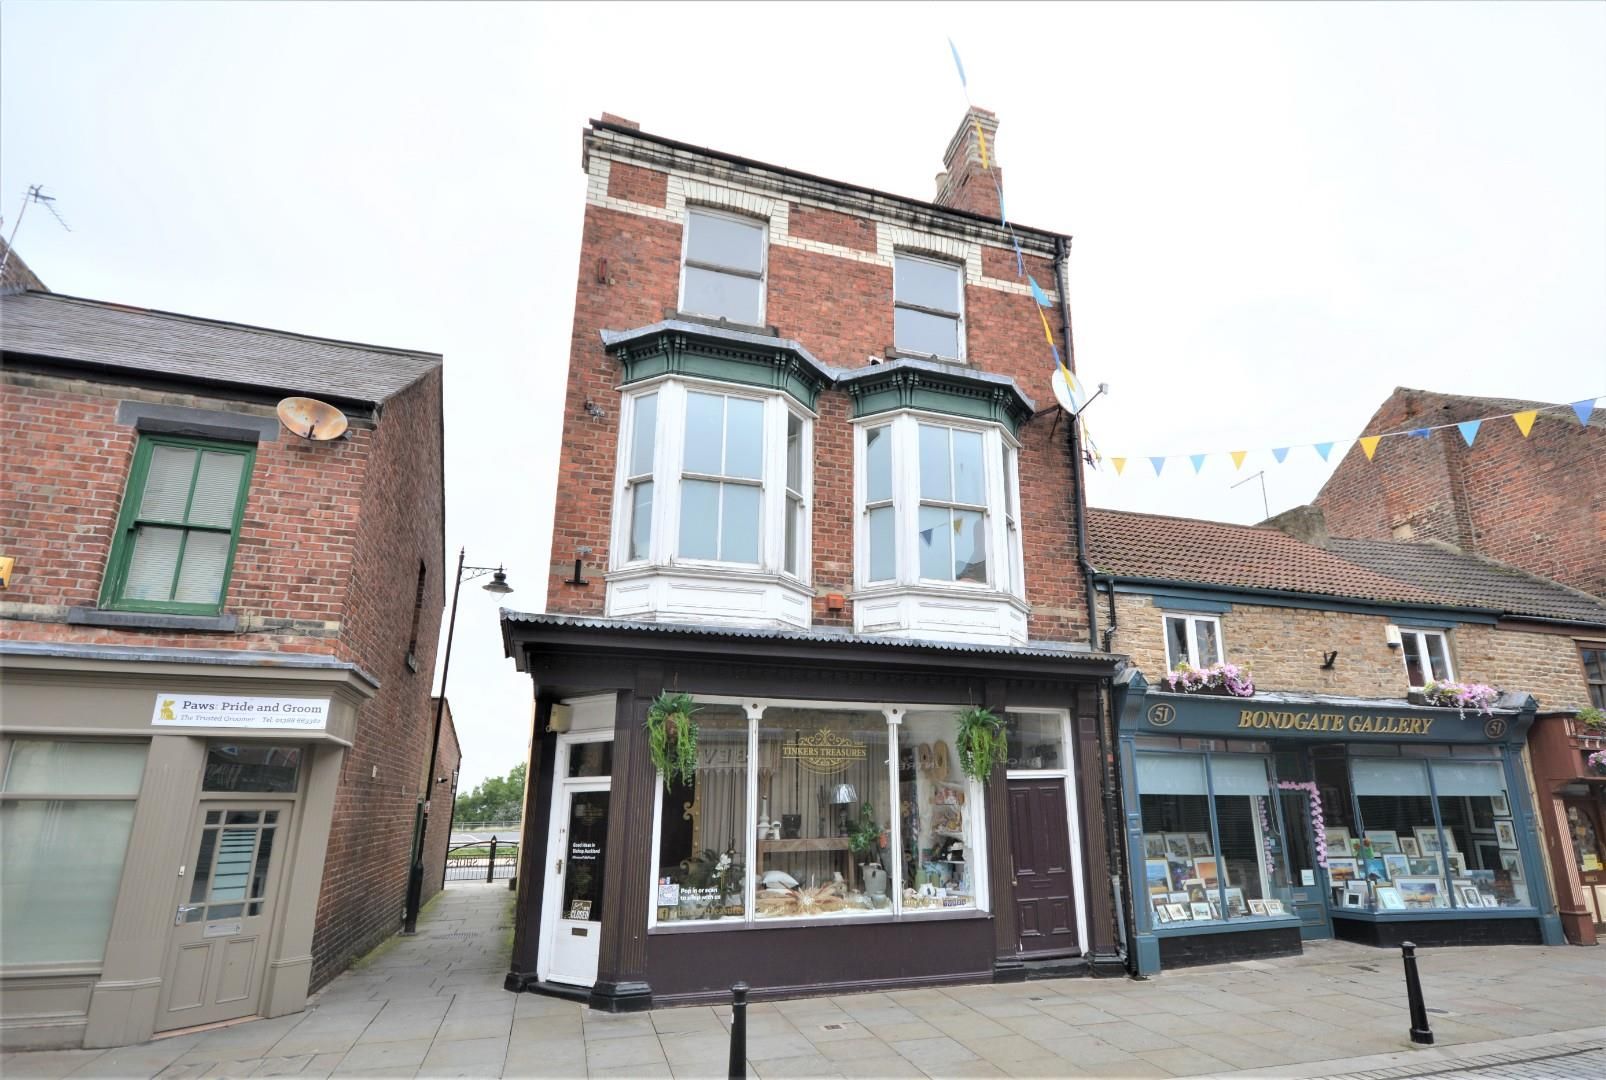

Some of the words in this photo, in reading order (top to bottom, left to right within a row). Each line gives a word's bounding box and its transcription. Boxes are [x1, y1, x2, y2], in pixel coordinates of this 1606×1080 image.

[221, 701, 254, 712] Pride
[256, 702, 280, 712] and
[282, 703, 322, 714] Groom
[195, 714, 223, 722] Trusted
[1154, 707, 1169, 722] 51
[1238, 710, 1345, 731] BONDGATE
[1348, 715, 1434, 734] GALLERY
[782, 747, 819, 756] TINKERS
[820, 748, 867, 757] TREASURES
